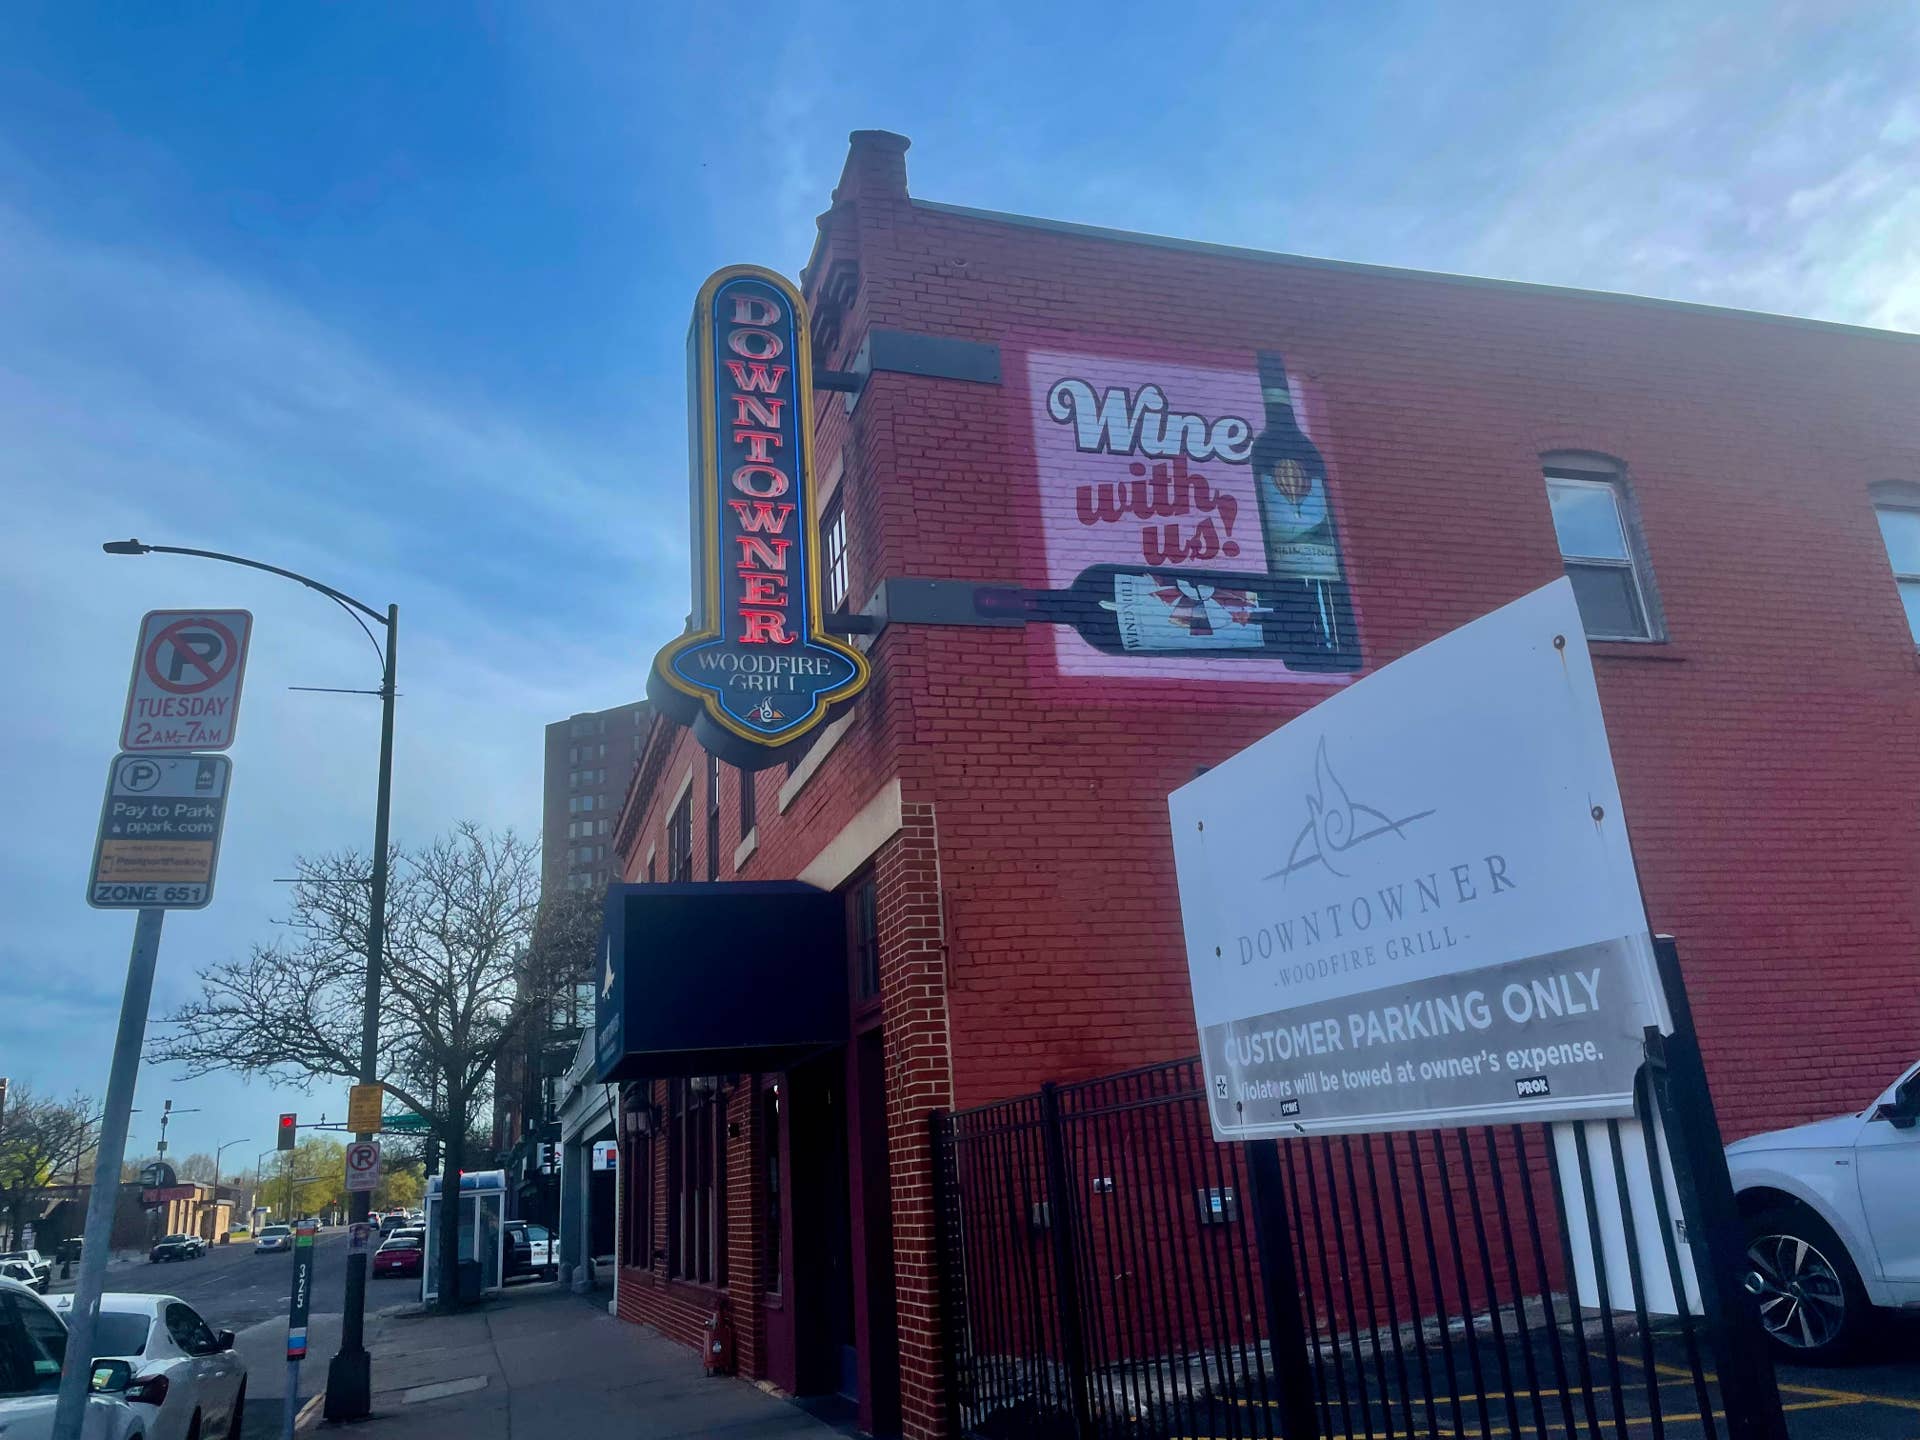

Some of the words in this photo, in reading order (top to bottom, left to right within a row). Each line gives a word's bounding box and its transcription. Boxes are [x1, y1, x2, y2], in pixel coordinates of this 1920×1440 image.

[1047, 377, 1254, 465] Wine
[727, 293, 798, 645] DOWNTOWNER
[1076, 456, 1223, 526] with
[1142, 494, 1241, 566] us!
[697, 653, 832, 676] WOODFIRE
[137, 697, 228, 717] TUESDAY
[113, 803, 146, 819] Pay
[151, 804, 169, 817] to
[174, 804, 215, 817] Park
[97, 886, 157, 900] ZONE
[164, 887, 201, 900] 651
[1237, 855, 1516, 966] DOWNTOWNER
[1279, 946, 1376, 988] WOODFIRE
[1386, 926, 1457, 961] GRILL
[1224, 1018, 1344, 1068] CUSTOMER
[1348, 990, 1492, 1049] PARKING
[1502, 968, 1601, 1024] ONLY
[1237, 1078, 1291, 1101] Violatrs
[1293, 1071, 1318, 1095] will
[1320, 1071, 1338, 1092] be
[1342, 1061, 1393, 1089] towed
[1397, 1060, 1416, 1083] at
[1506, 1040, 1604, 1072] expense.
[297, 1264, 306, 1308] 325
